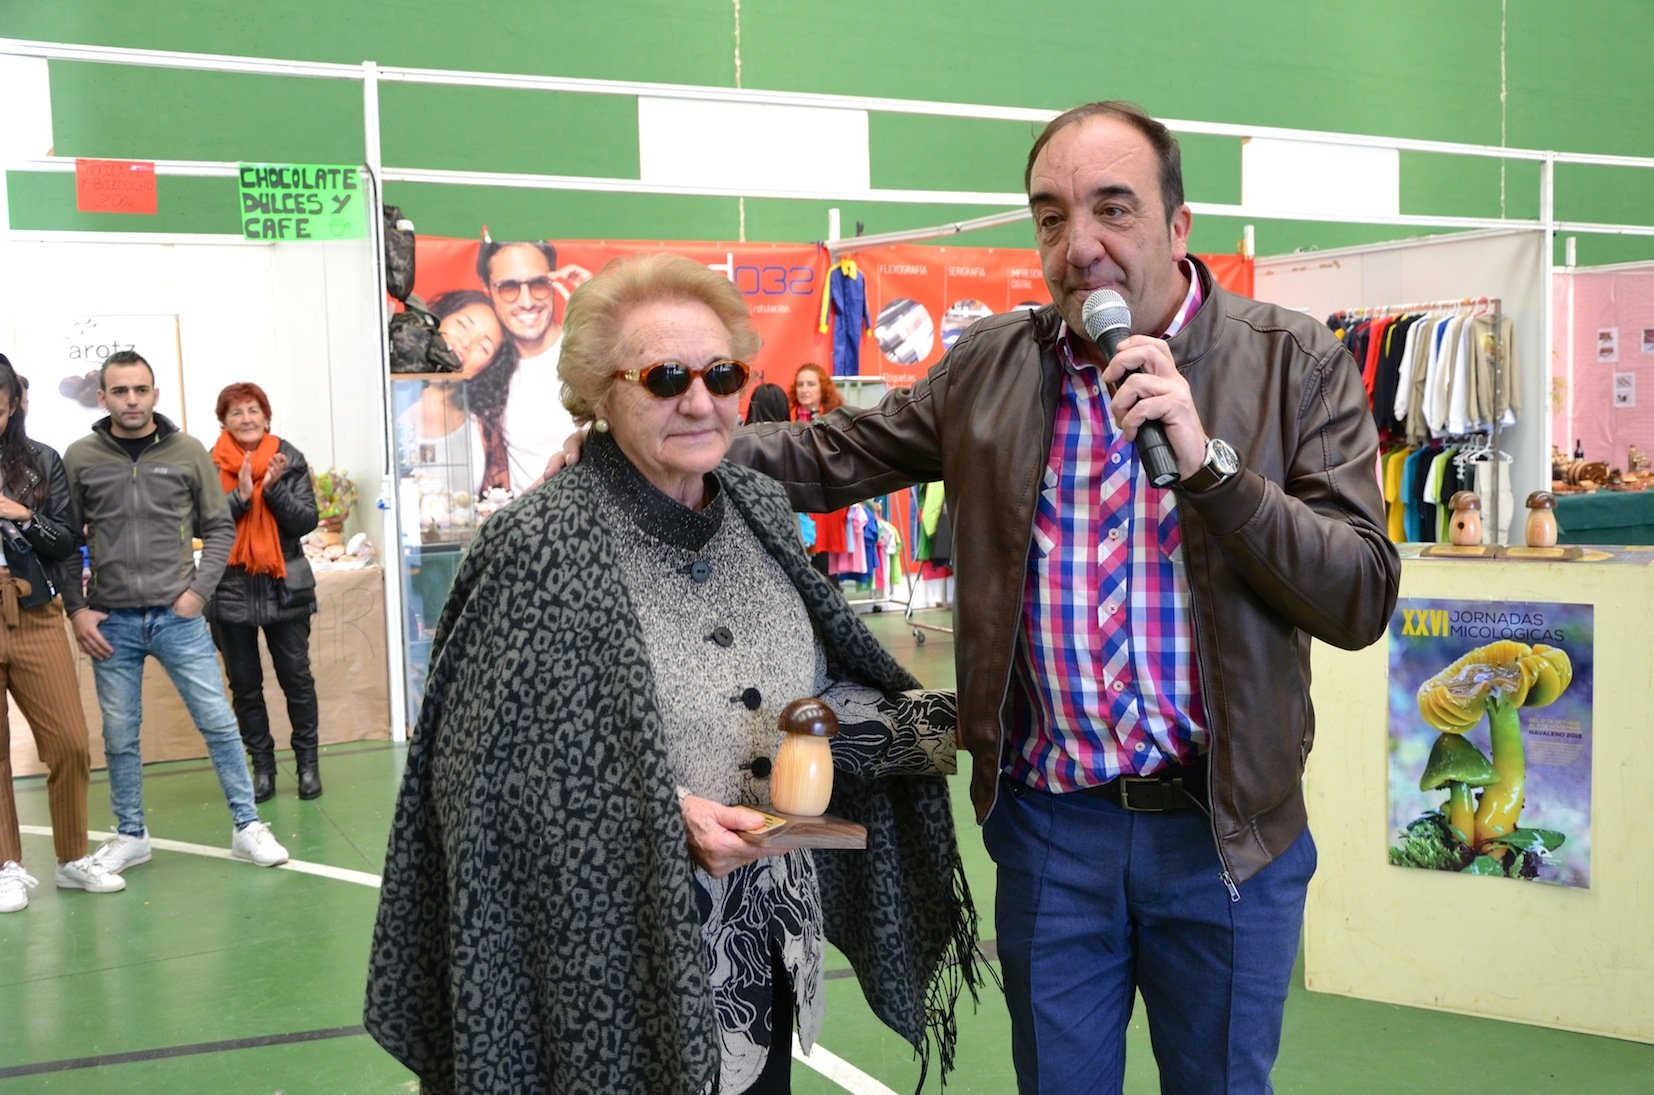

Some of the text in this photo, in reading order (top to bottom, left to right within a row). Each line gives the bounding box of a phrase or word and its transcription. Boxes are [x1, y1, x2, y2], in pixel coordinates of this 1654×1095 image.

[240, 167, 357, 190] CHOCOLATE
[242, 192, 352, 215] DULCES Y
[244, 218, 311, 239] CAFE
[1401, 608, 1449, 637] XXVI
[1449, 611, 1544, 626] JORNADAS
[1450, 625, 1566, 642] MICOLÓGICAS
[1529, 729, 1565, 738] NAVALENO
